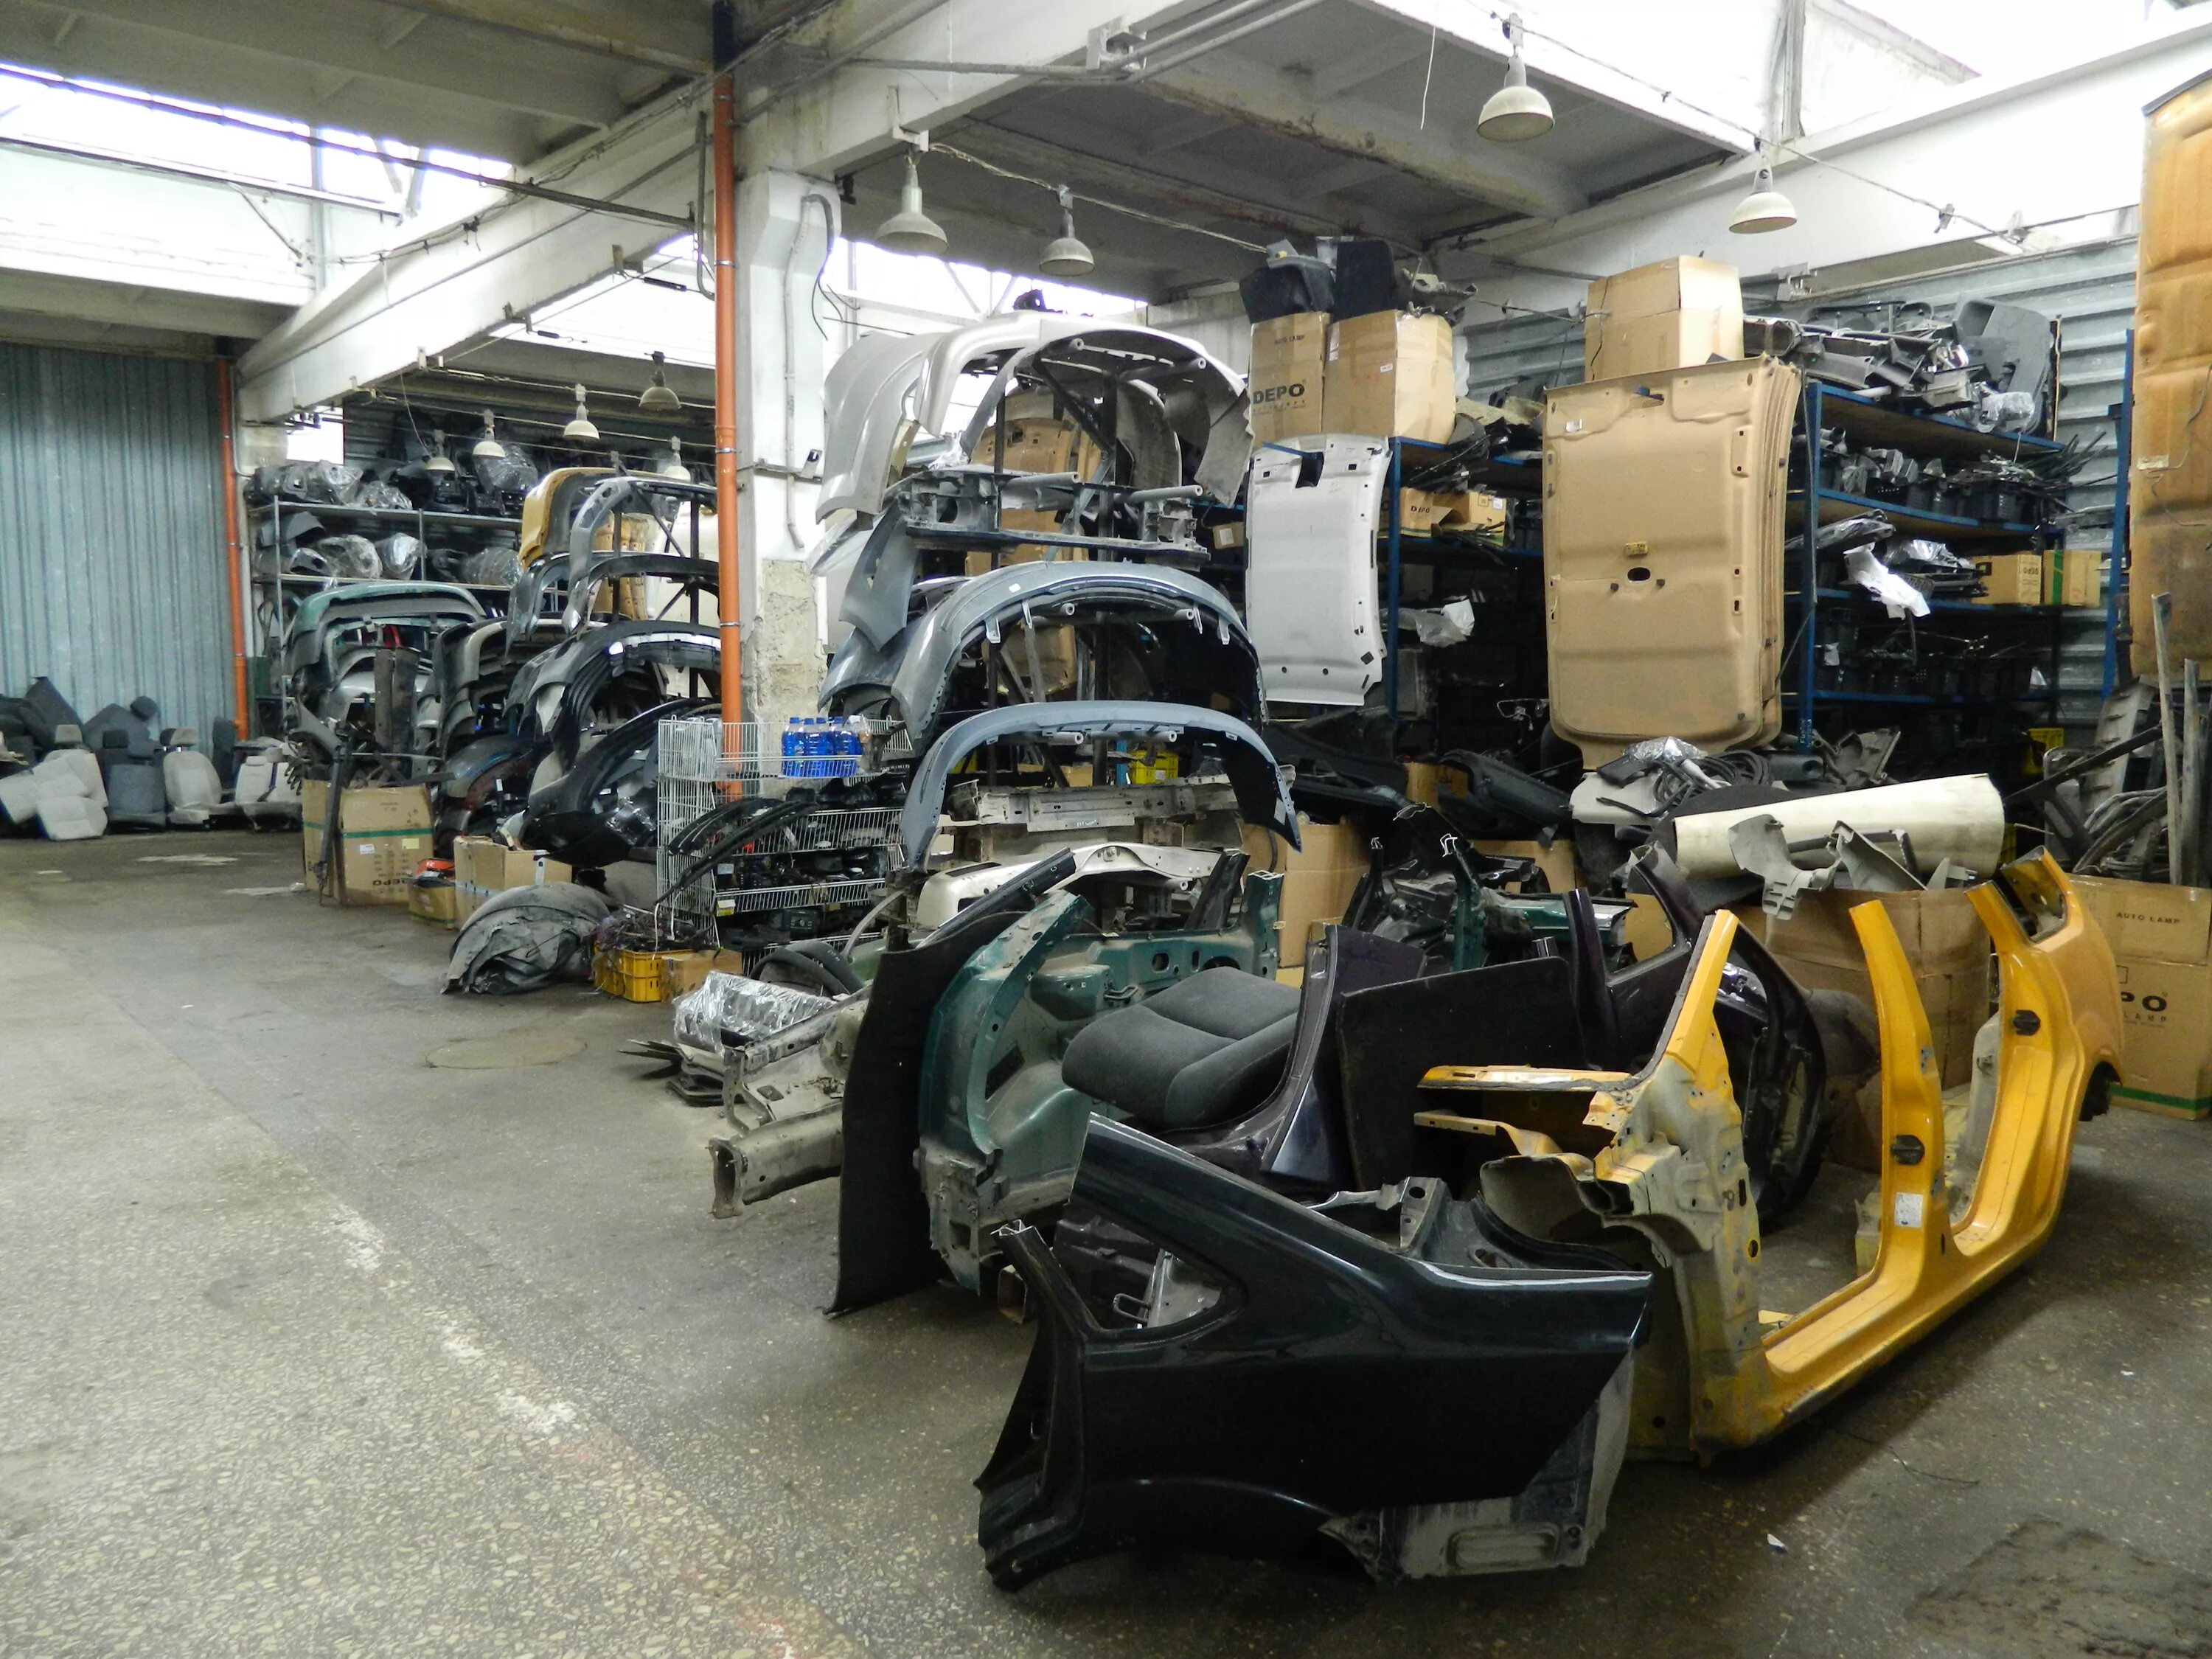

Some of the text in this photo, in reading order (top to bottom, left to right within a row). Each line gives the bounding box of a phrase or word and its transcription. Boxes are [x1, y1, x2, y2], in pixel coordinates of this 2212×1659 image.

[1253, 383, 1305, 404] DEPO
[2116, 912, 2145, 921] AUTO
[2121, 992, 2167, 1012] PO
